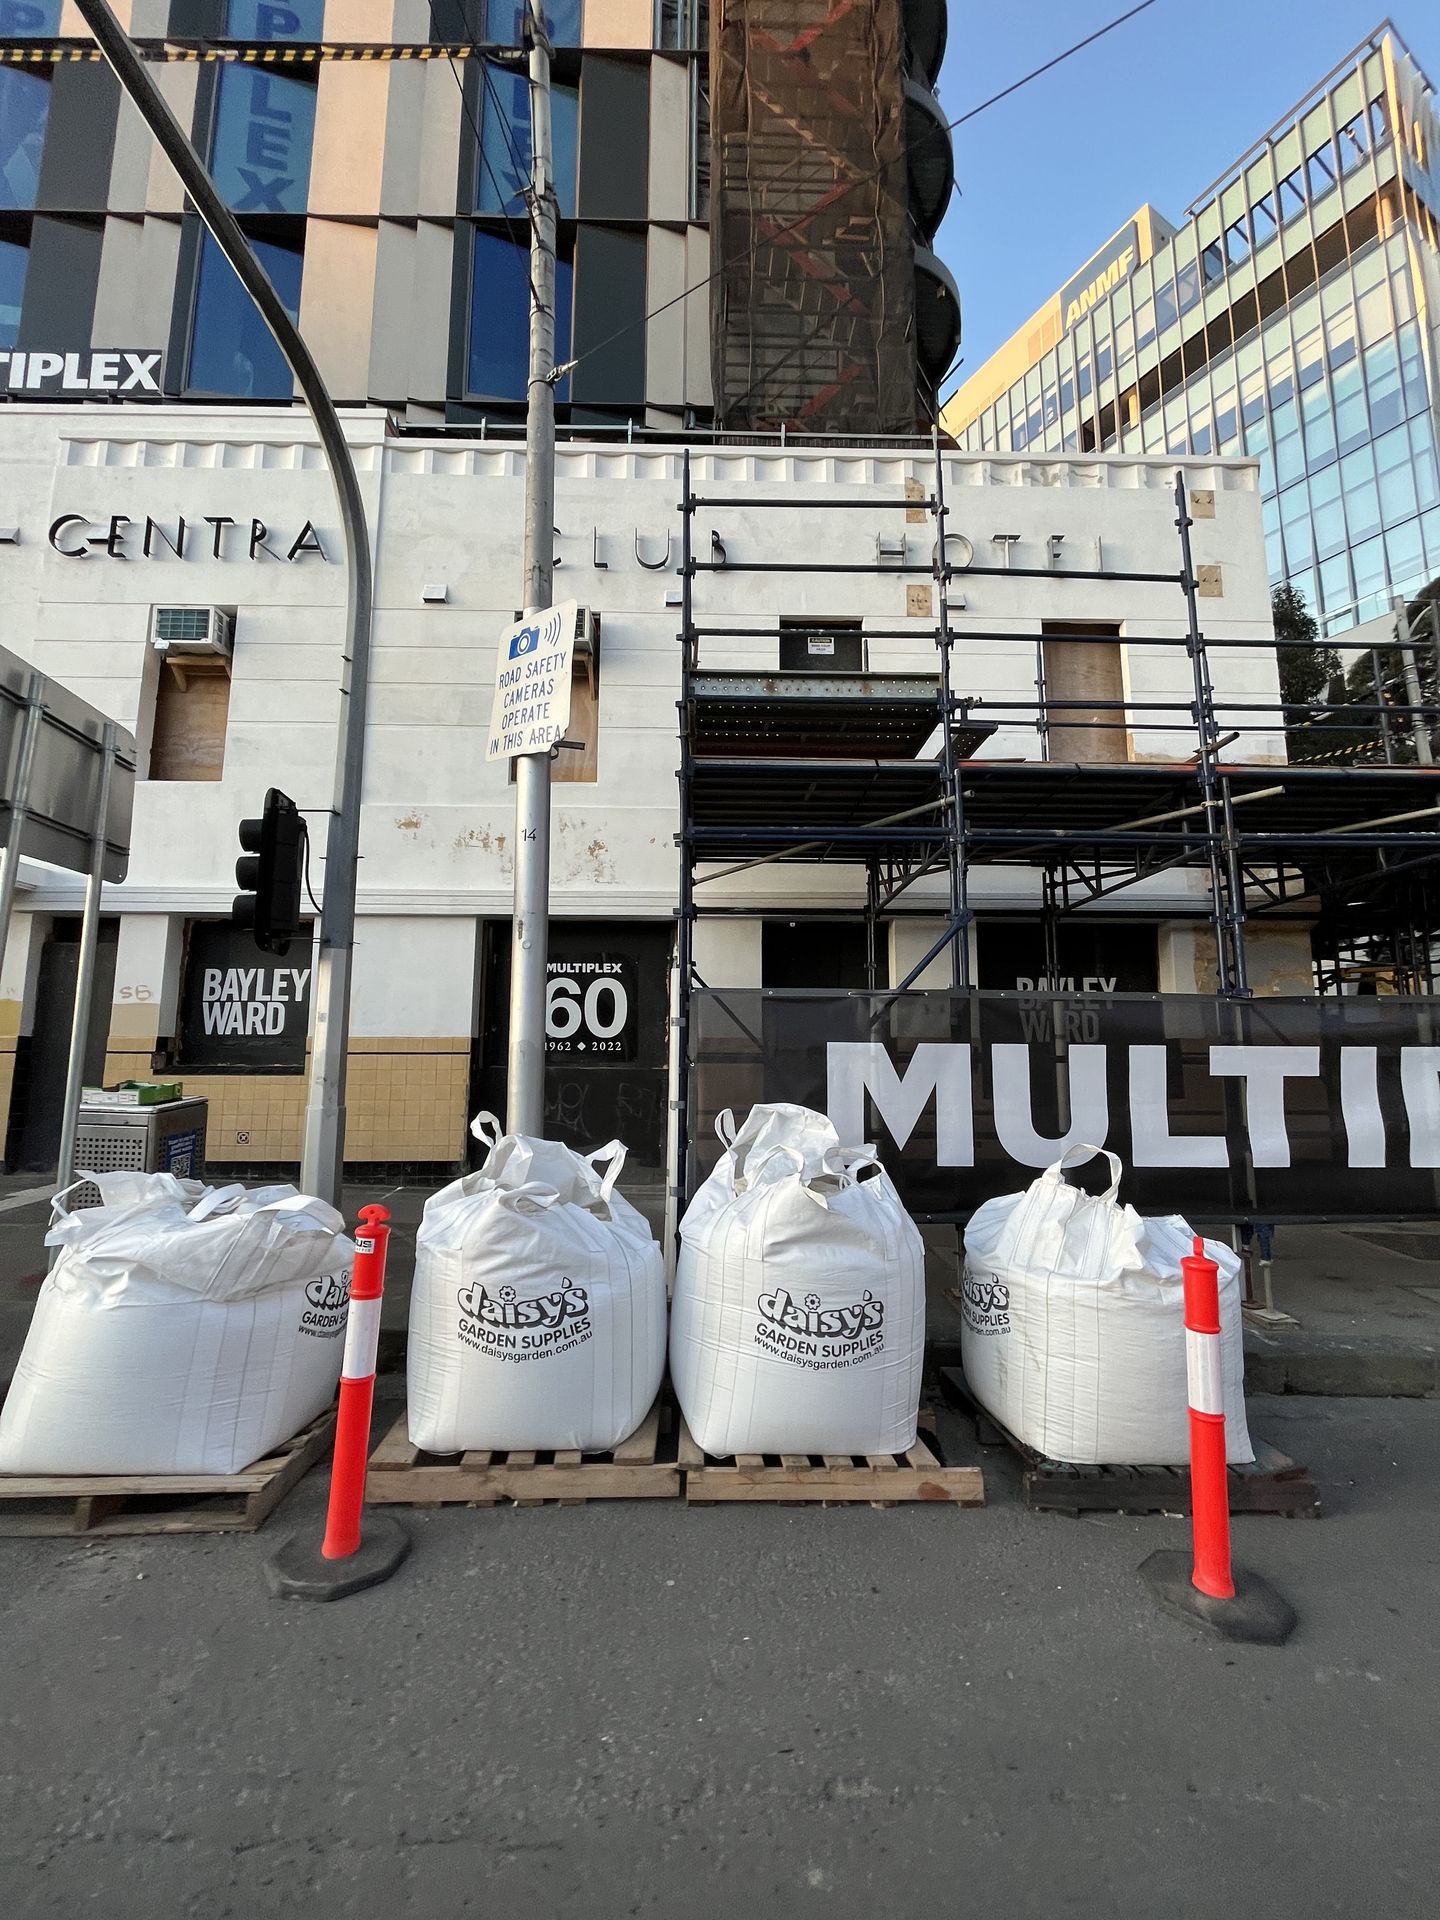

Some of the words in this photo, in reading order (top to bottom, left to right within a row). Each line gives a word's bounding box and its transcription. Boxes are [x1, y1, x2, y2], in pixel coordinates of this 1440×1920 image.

[1065, 244, 1134, 330] ANMF
[499, 666, 522, 690] ROAD
[525, 651, 567, 679] SAFETY
[503, 678, 554, 709] CAMERAS
[501, 702, 550, 730] OPERATE
[490, 738, 500, 755] IN
[503, 731, 523, 751] THIS
[522, 828, 537, 842] 14
[202, 968, 311, 1001] BAYLEY
[203, 1001, 286, 1035] WARD
[545, 977, 628, 1039] 60
[592, 1041, 622, 1051] 2022
[302, 1311, 340, 1328] GARDEN
[458, 1319, 517, 1349] GARDEN
[521, 1317, 592, 1350] SUPPLIES
[457, 1331, 593, 1364] www.daisysgarden.com.au
[754, 1333, 885, 1371] www.daisysgarden.com.au
[757, 1323, 818, 1357] GARDEN
[822, 1331, 884, 1358] SUPPLIES
